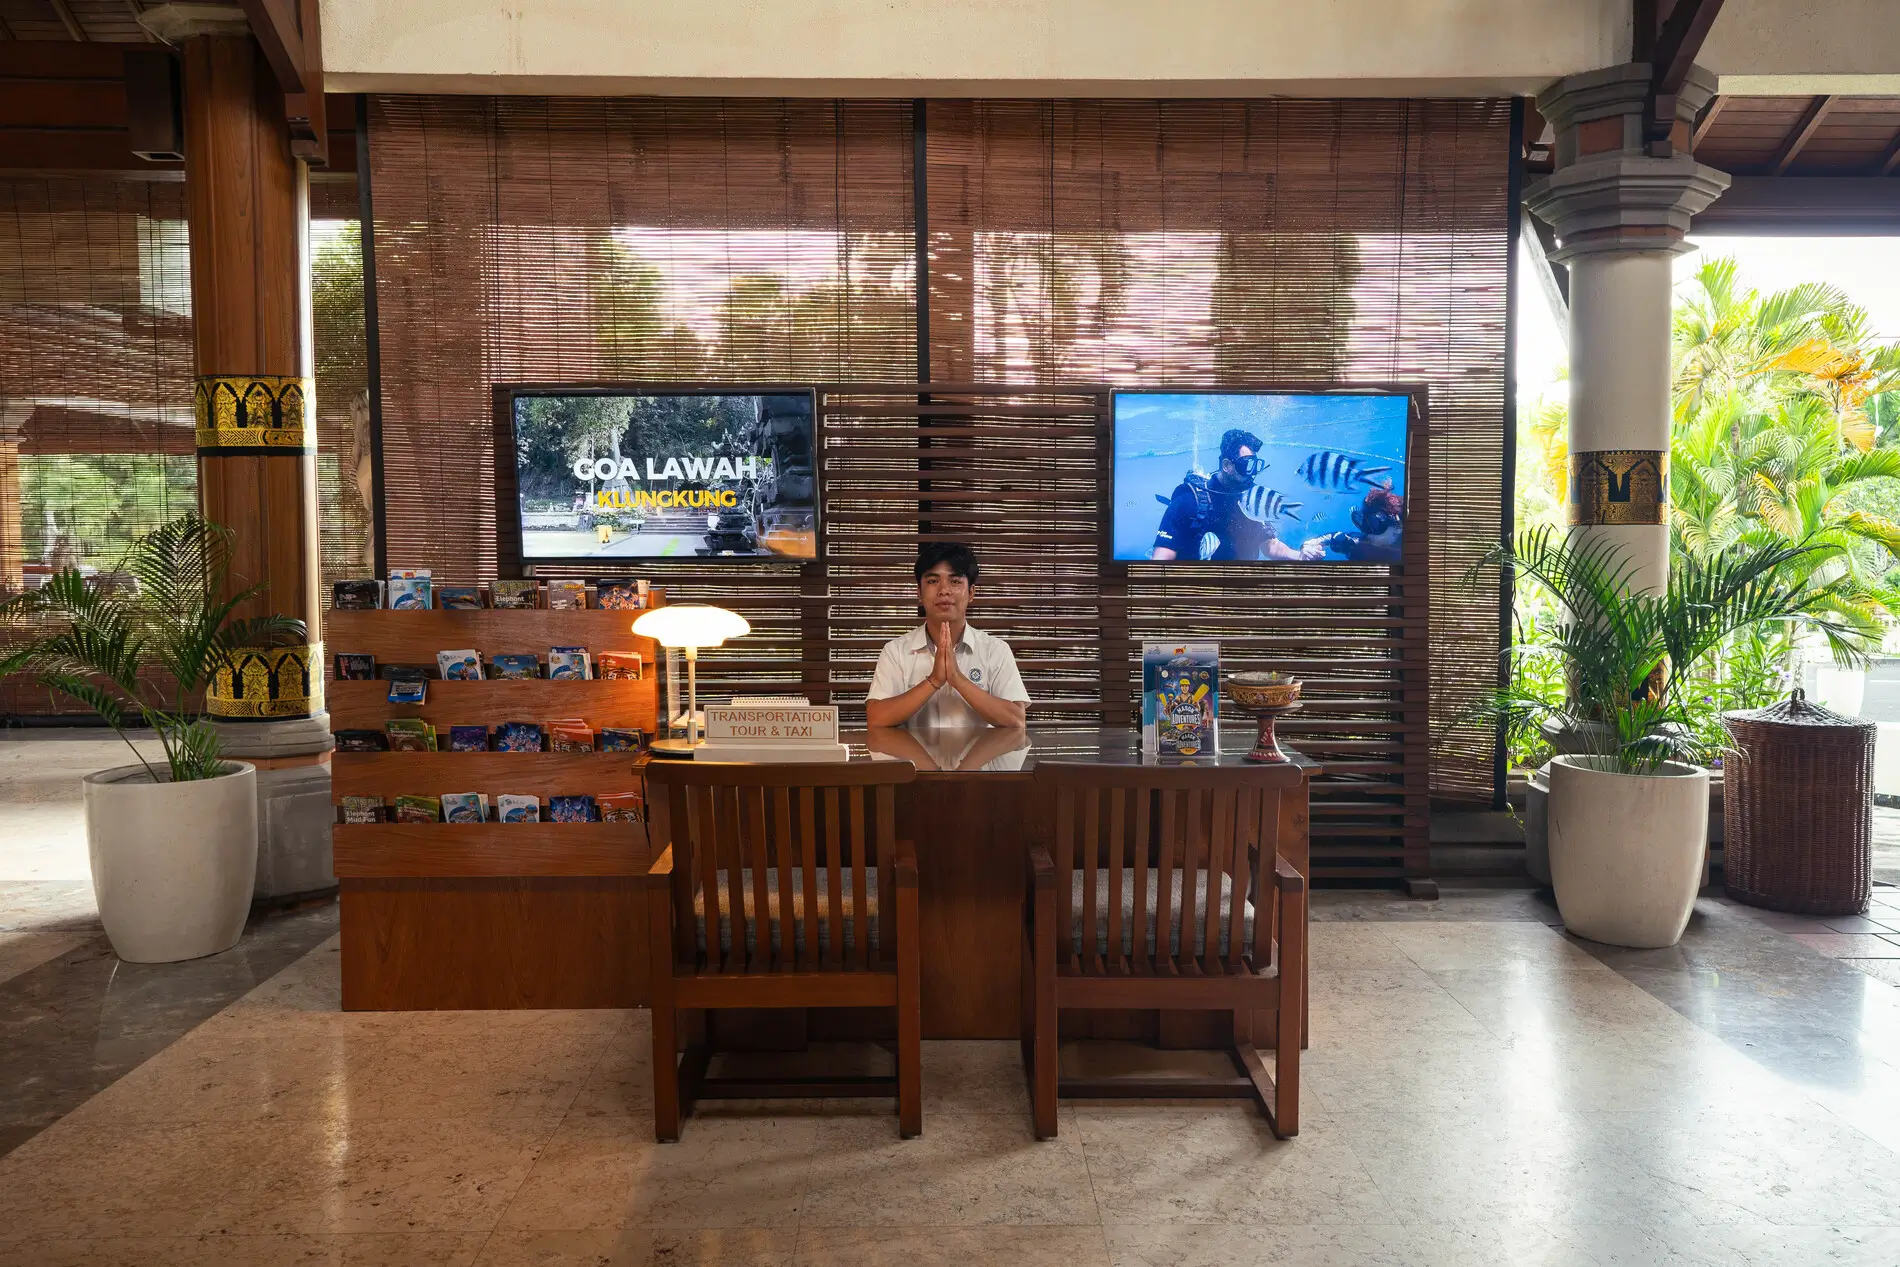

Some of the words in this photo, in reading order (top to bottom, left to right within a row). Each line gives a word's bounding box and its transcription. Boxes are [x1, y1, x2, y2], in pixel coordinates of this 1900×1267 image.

[573, 457, 640, 481] GOA
[646, 456, 756, 480] LAWAH
[597, 489, 737, 508] KLUNGKUNG
[496, 595, 525, 603] Elephant
[711, 711, 832, 722] TRANSPORTATION
[730, 725, 767, 736] TOUR
[770, 725, 780, 737] &
[783, 726, 813, 737] TAXI
[346, 811, 375, 819] Elephant
